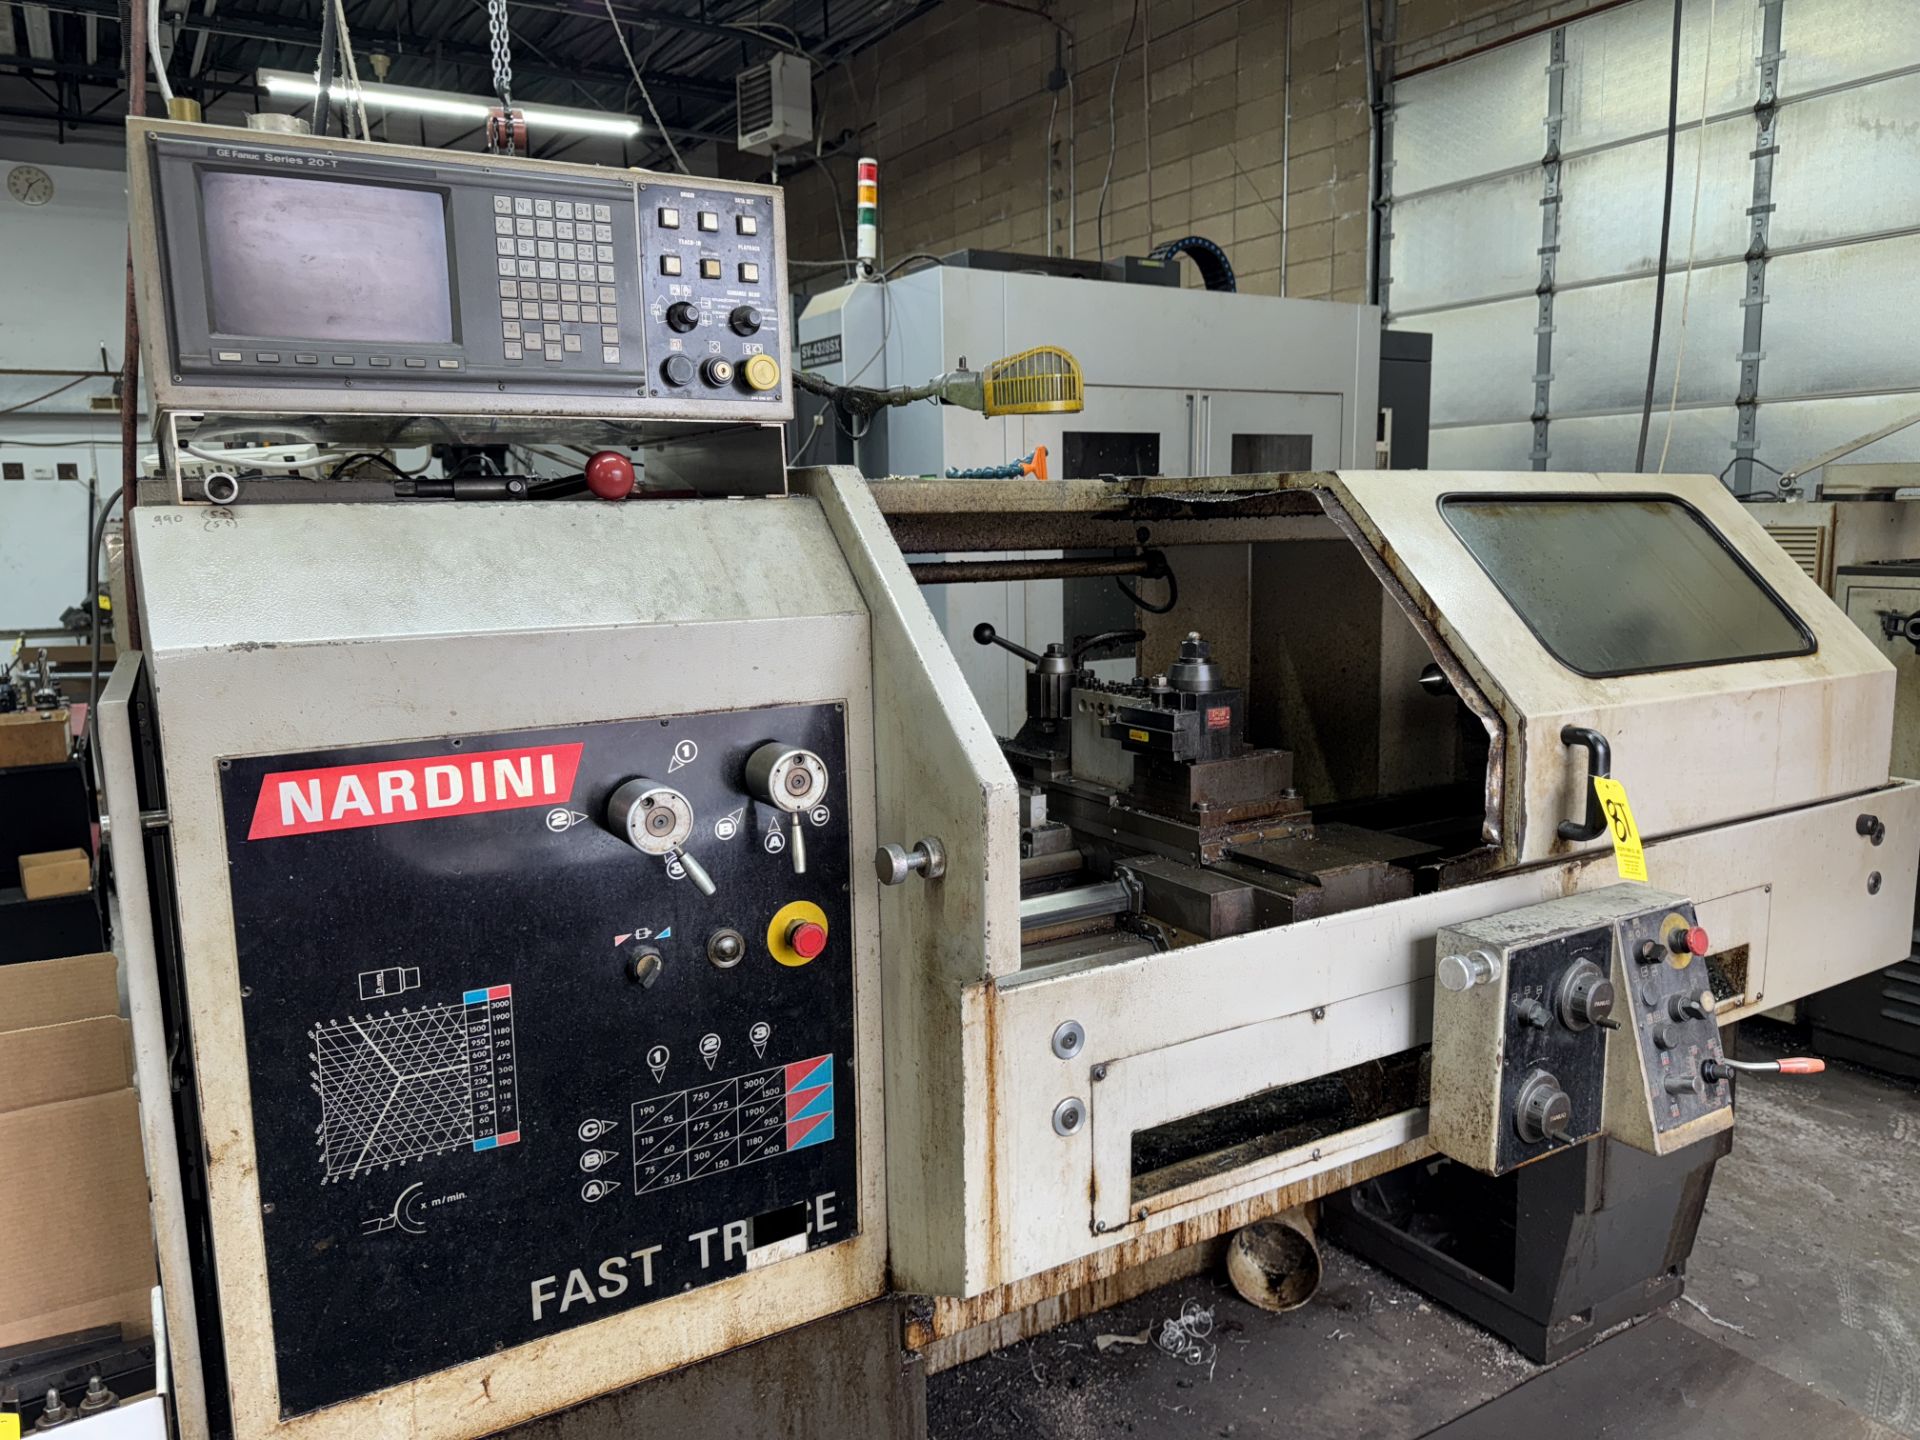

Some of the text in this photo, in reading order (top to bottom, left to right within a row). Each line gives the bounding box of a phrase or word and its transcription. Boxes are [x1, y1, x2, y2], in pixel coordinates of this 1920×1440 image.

[216, 148, 338, 168] GE Fanuc Series 20-T
[278, 754, 556, 826] NARDINI
[491, 1000, 509, 1009] 3000
[493, 1012, 510, 1022] 1900
[470, 1025, 510, 1035] 1500 1180
[496, 1040, 510, 1048] 750
[472, 1051, 487, 1059] 600
[744, 1077, 764, 1089] 3000
[500, 1092, 511, 1100] 118
[693, 1092, 710, 1101] 750
[762, 1087, 780, 1098] 1500
[640, 1106, 654, 1116] 190
[712, 1101, 728, 1111] 375
[745, 1106, 765, 1117] 1900
[664, 1115, 674, 1123] 95
[764, 1117, 778, 1126] 950
[693, 1122, 710, 1131] 475
[713, 1131, 729, 1140] 236
[641, 1136, 654, 1146] 118
[746, 1136, 763, 1147] 1180
[664, 1145, 675, 1153] 60
[764, 1145, 779, 1155] 600
[694, 1152, 710, 1162] 300
[715, 1160, 729, 1169] 150
[645, 1166, 655, 1175] 75
[531, 1191, 838, 1321] FAST TRE
